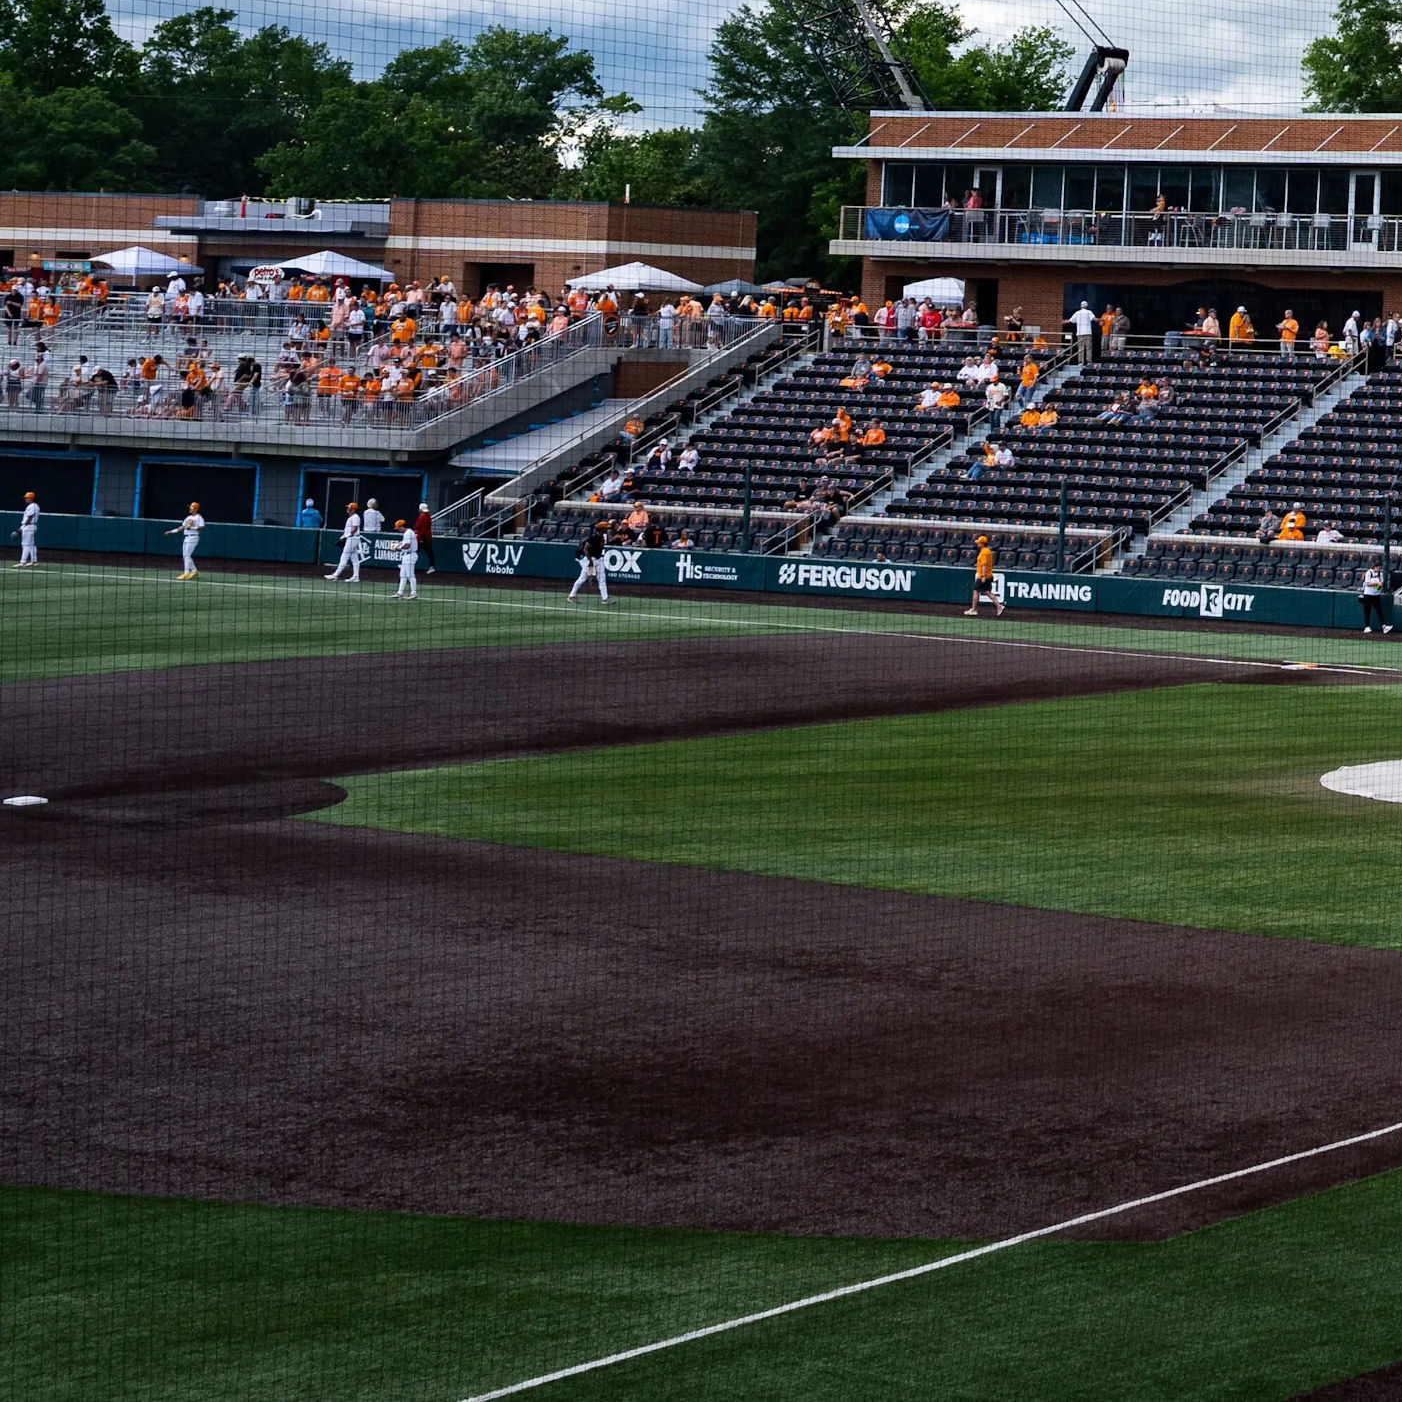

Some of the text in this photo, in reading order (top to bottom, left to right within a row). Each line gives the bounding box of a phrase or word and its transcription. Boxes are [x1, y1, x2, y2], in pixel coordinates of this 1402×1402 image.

[486, 543, 524, 566] RJV
[601, 549, 642, 574] OX
[486, 565, 514, 575] Kubota
[797, 564, 912, 592] FERGUSON
[1006, 581, 1092, 602] TRAINING
[1162, 589, 1255, 612] FOOD CITY
